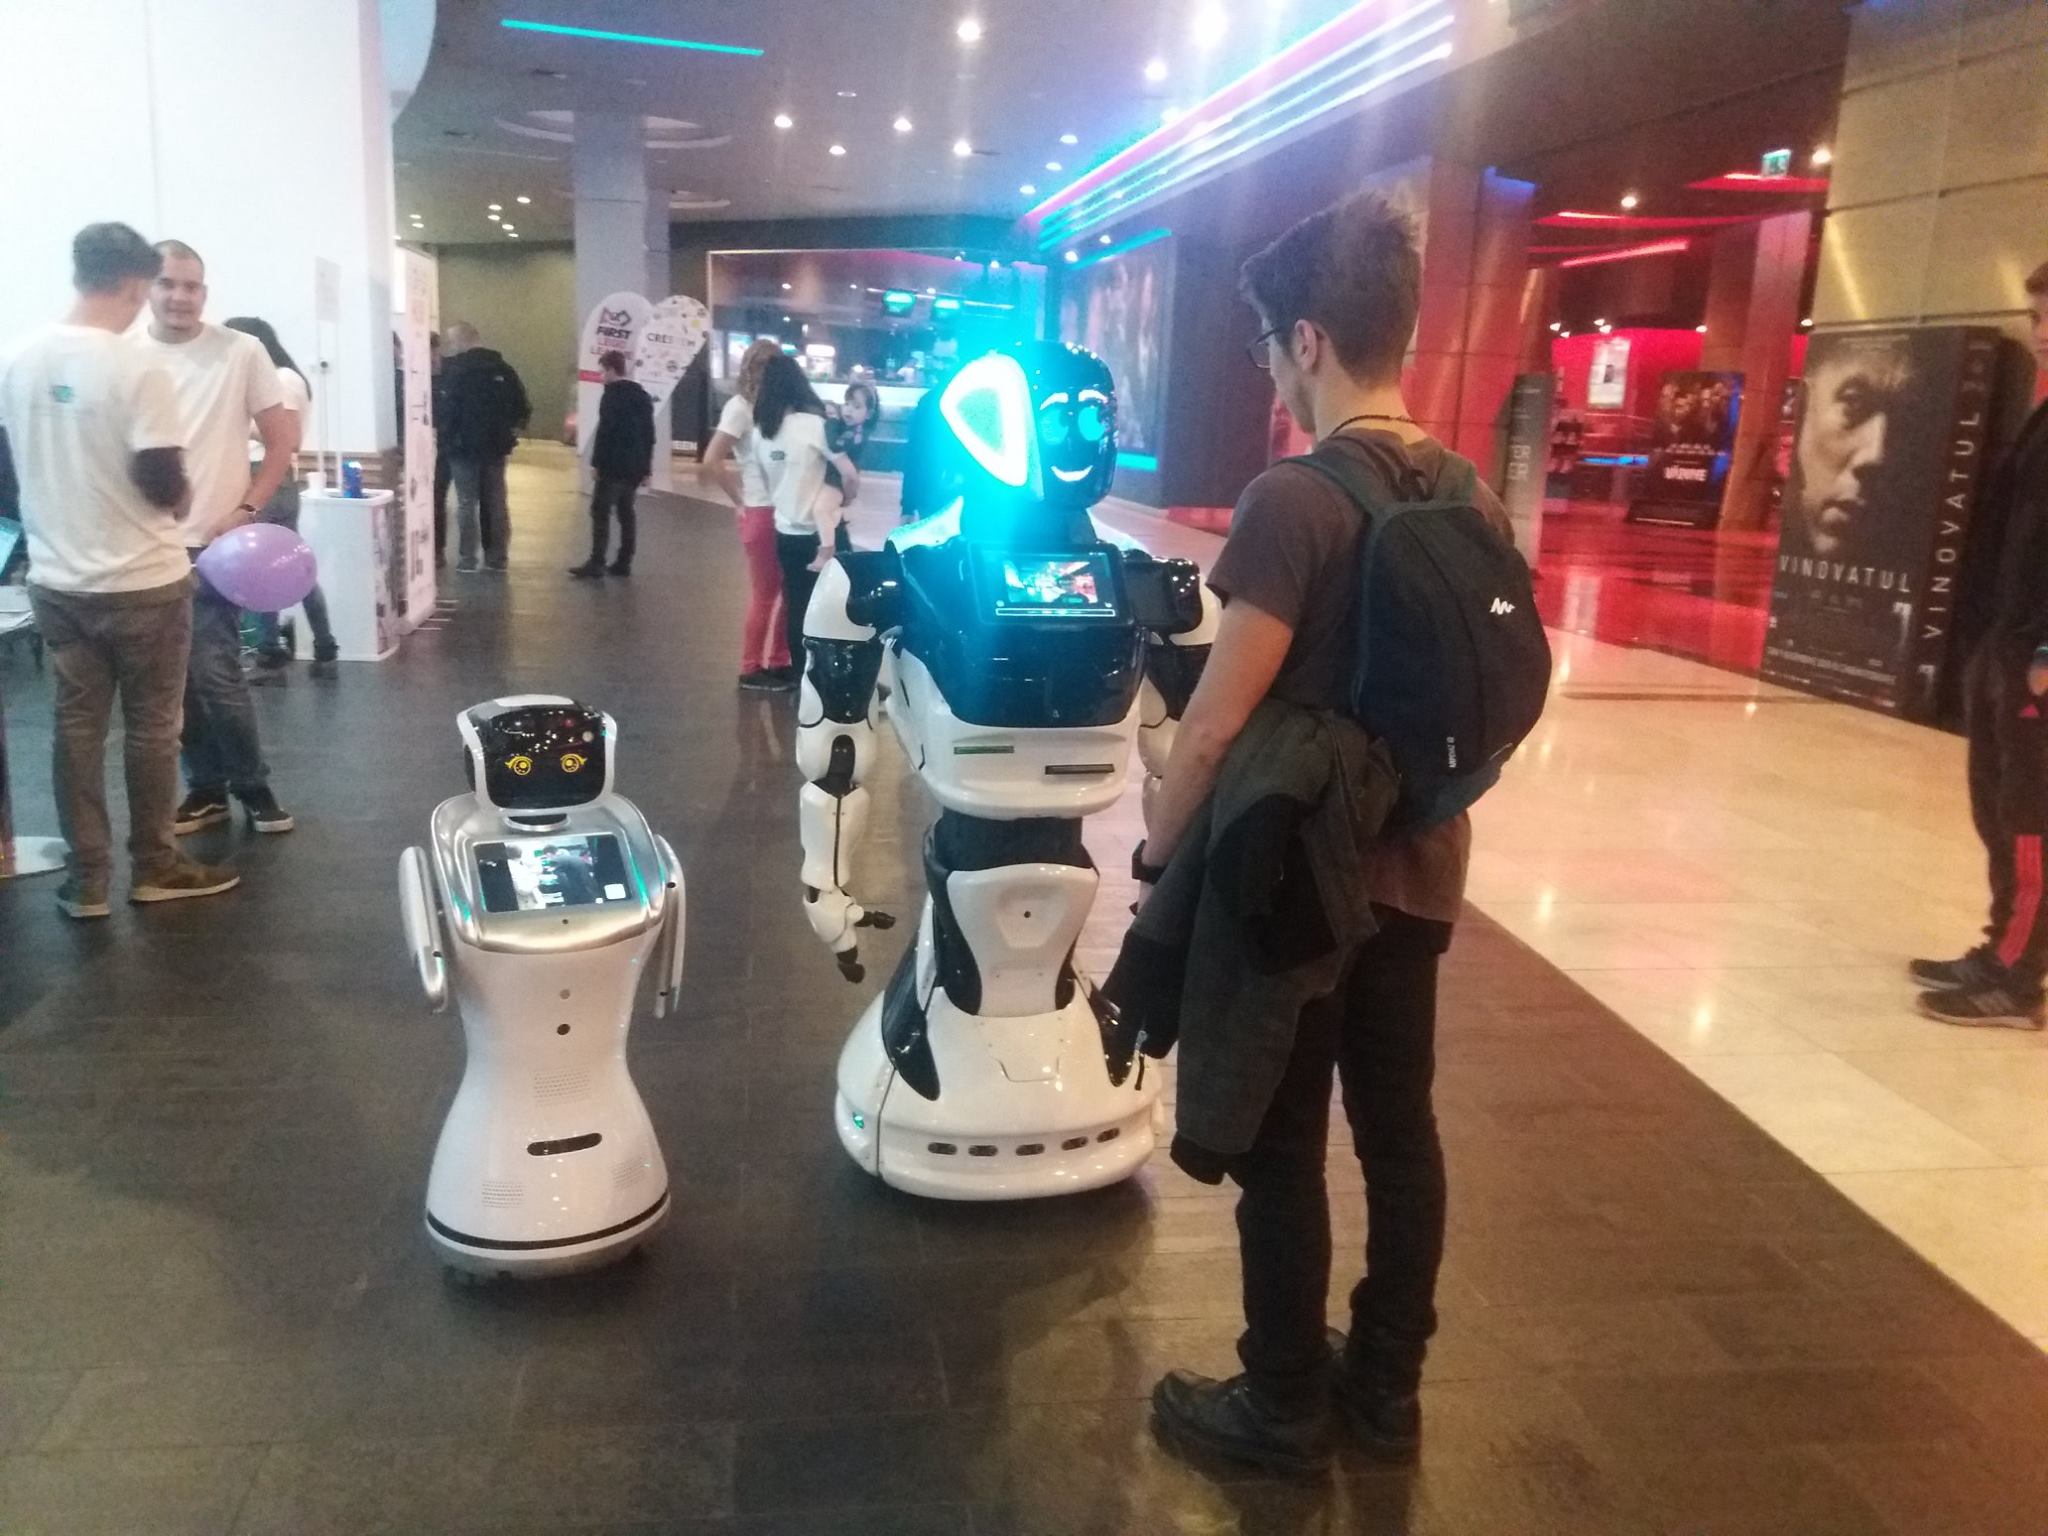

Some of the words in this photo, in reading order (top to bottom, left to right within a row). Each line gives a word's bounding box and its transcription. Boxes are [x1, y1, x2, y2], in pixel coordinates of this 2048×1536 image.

[596, 325, 632, 340] FIRST
[1922, 411, 1981, 639] VINOVATUL
[1779, 554, 1911, 593] VINOVATUL
